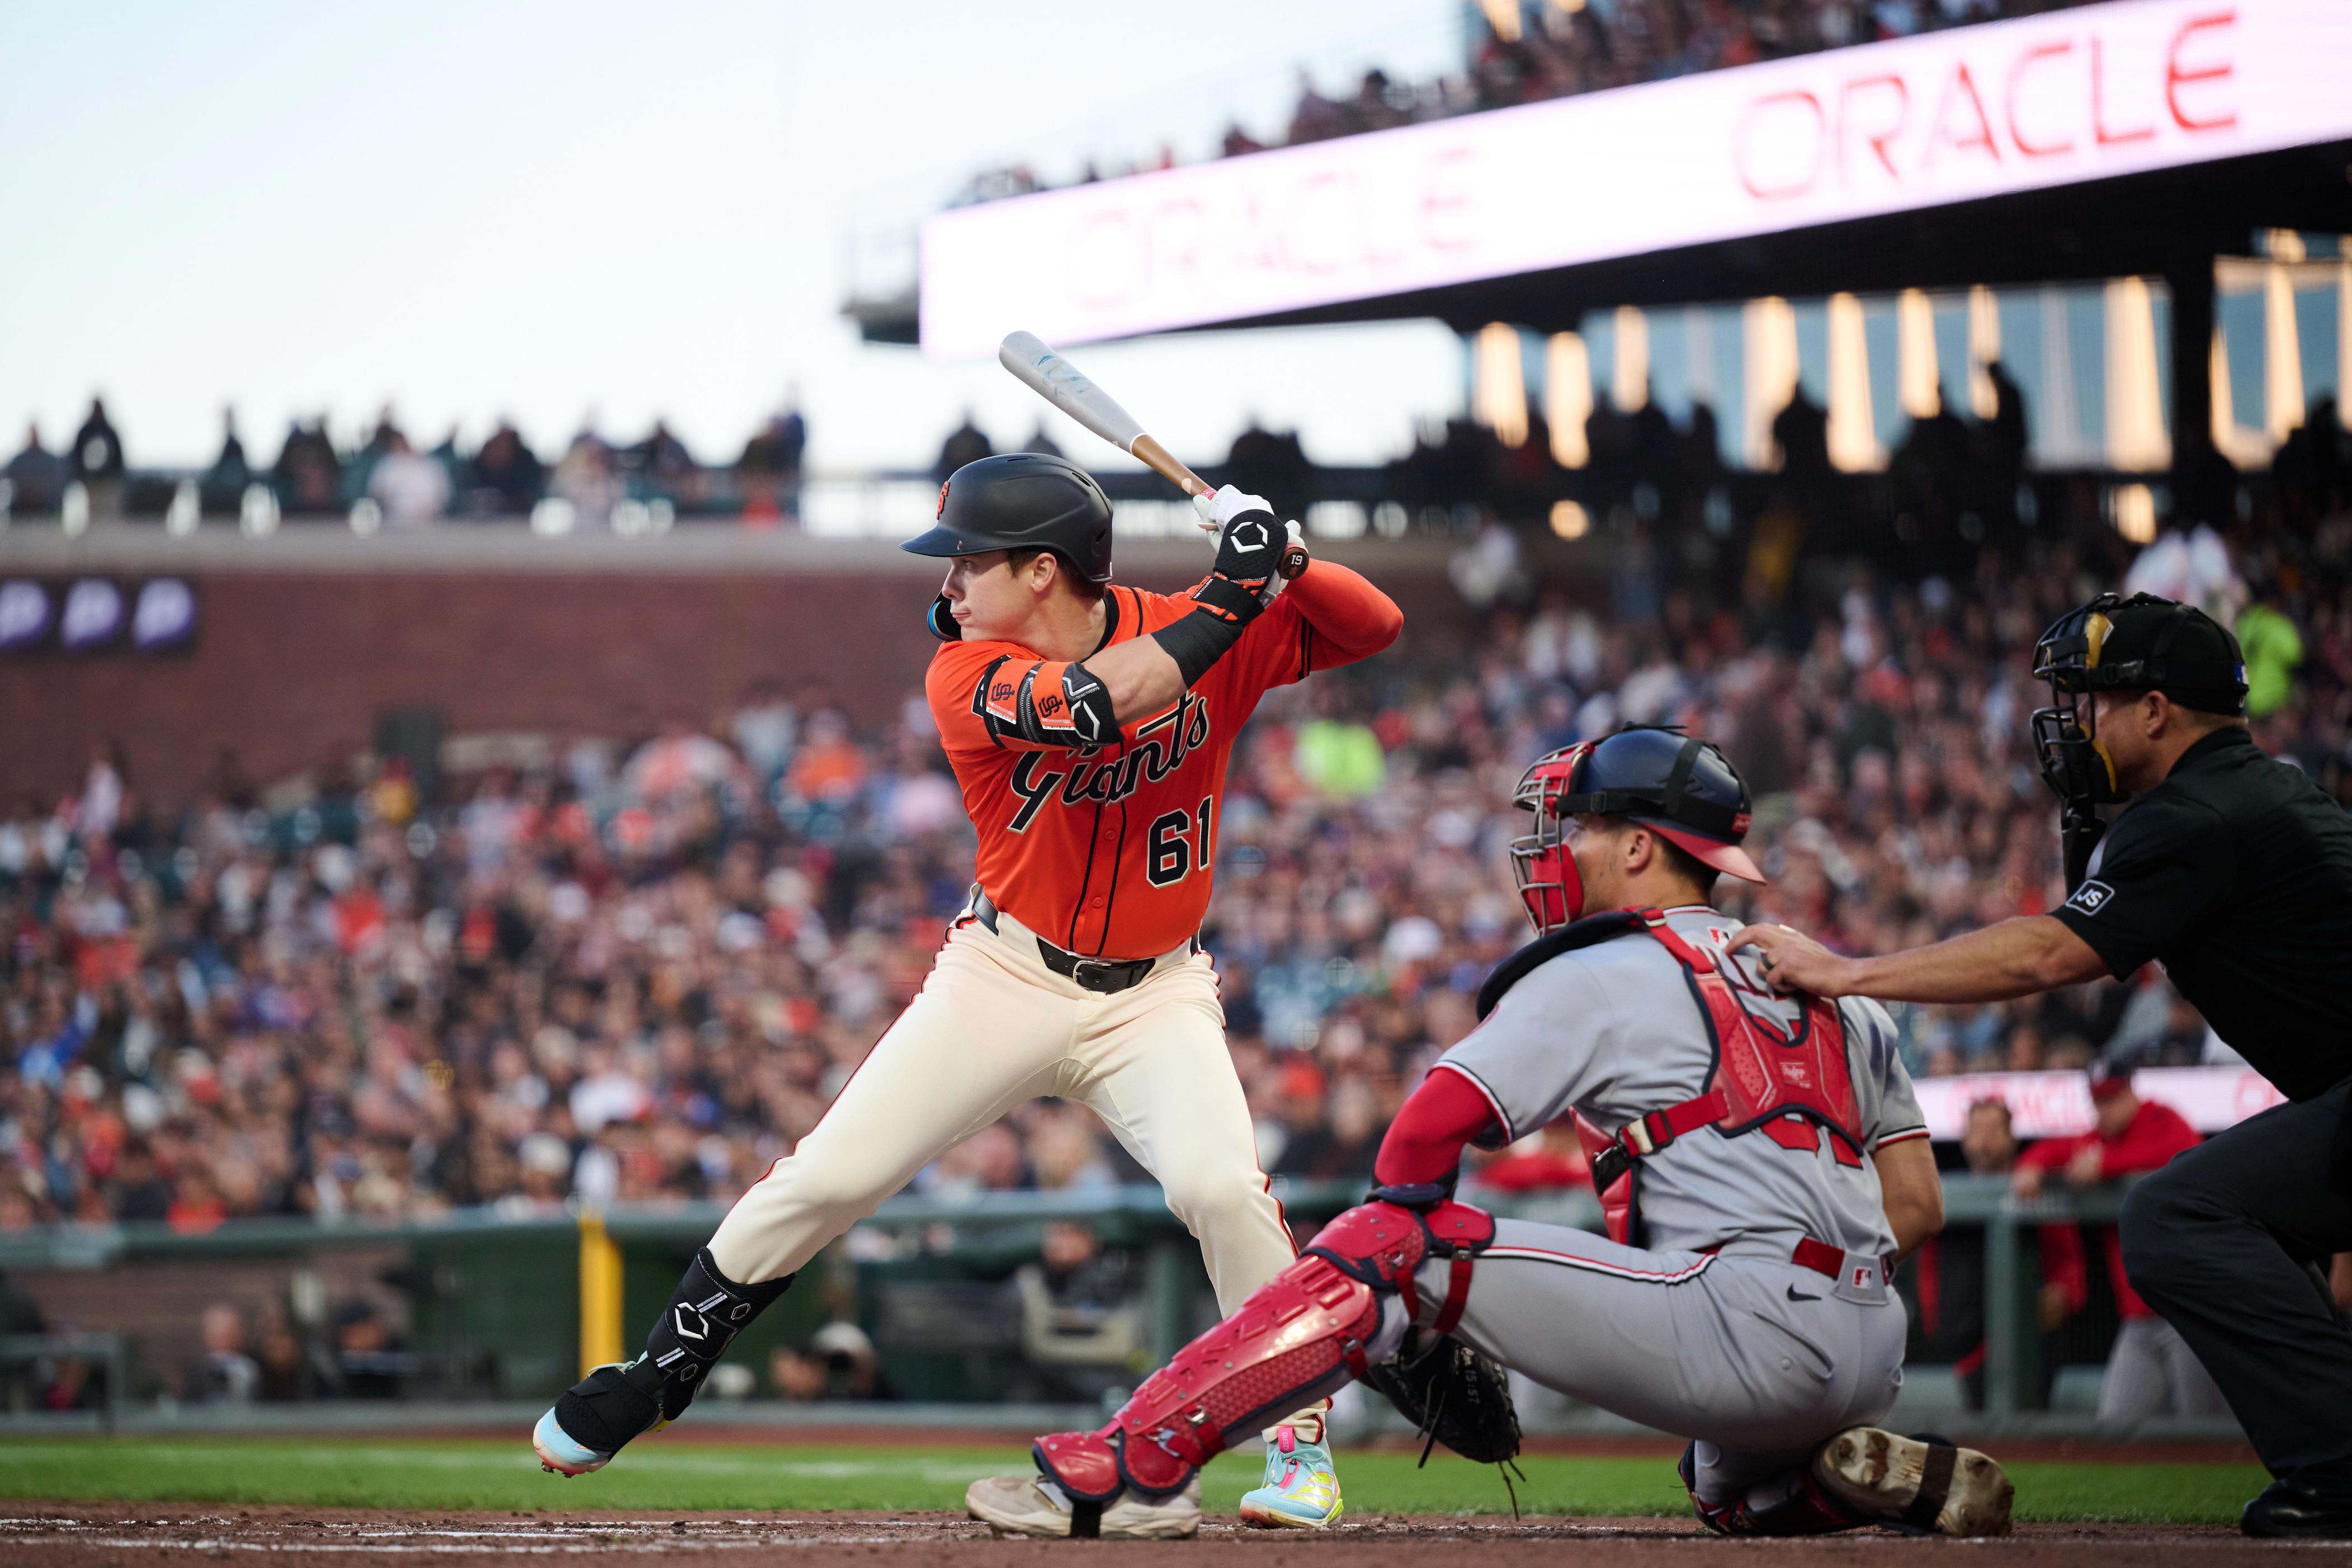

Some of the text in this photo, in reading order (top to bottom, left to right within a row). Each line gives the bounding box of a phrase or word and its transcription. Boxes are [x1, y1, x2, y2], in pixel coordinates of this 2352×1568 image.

[1735, 8, 2242, 202] ORACLE
[1064, 145, 1481, 311] ORACLE
[1007, 689, 1211, 835] Giants
[1146, 795, 1213, 889] 61
[2076, 888, 2103, 907] JS
